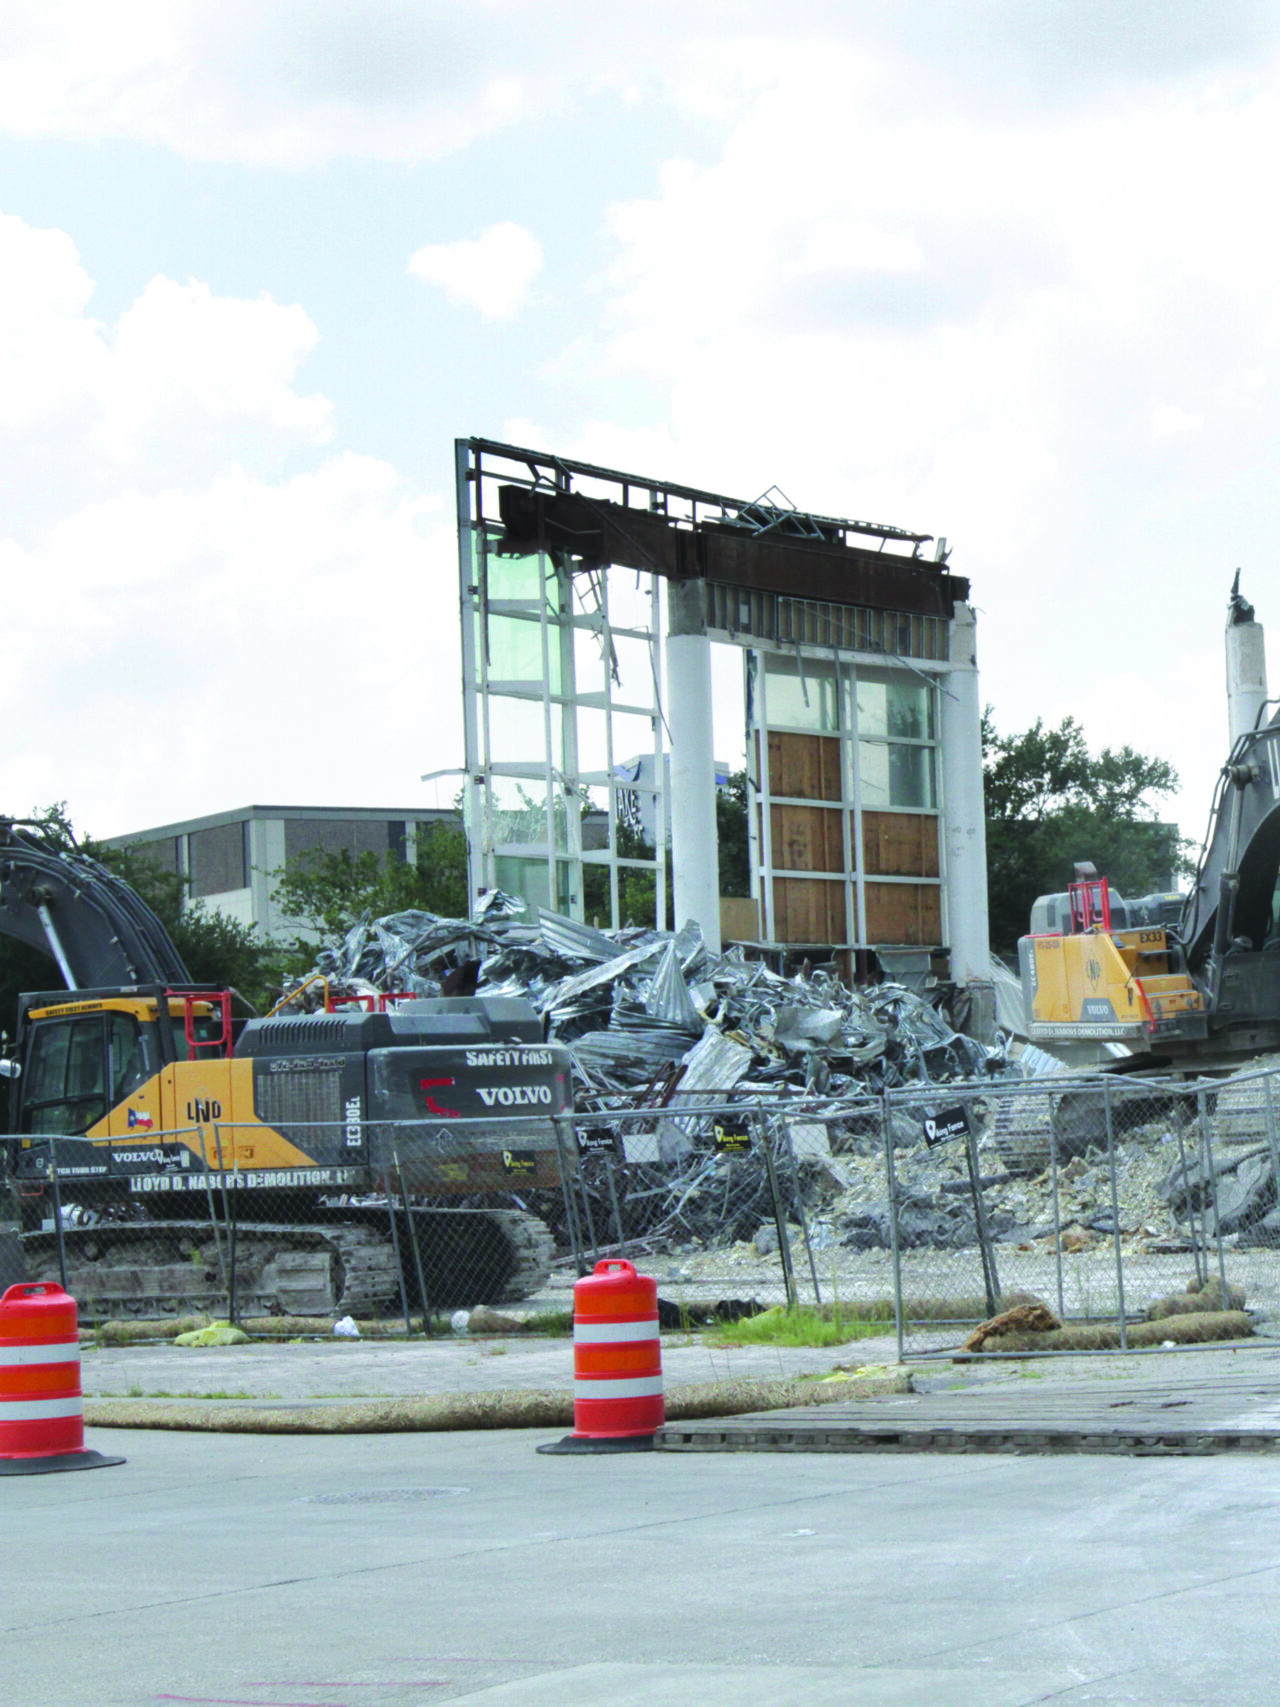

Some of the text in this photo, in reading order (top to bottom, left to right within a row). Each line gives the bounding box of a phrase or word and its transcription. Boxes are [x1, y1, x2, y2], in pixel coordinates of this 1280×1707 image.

[1139, 931, 1162, 943] EX33
[1087, 1004, 1109, 1015] VOLVO
[466, 1050, 553, 1066] SAFETY FIRST
[475, 1086, 552, 1106] VOLVO
[187, 1098, 221, 1123] LND
[90, 1166, 107, 1174] STEP
[131, 1176, 170, 1191] LLOYD
